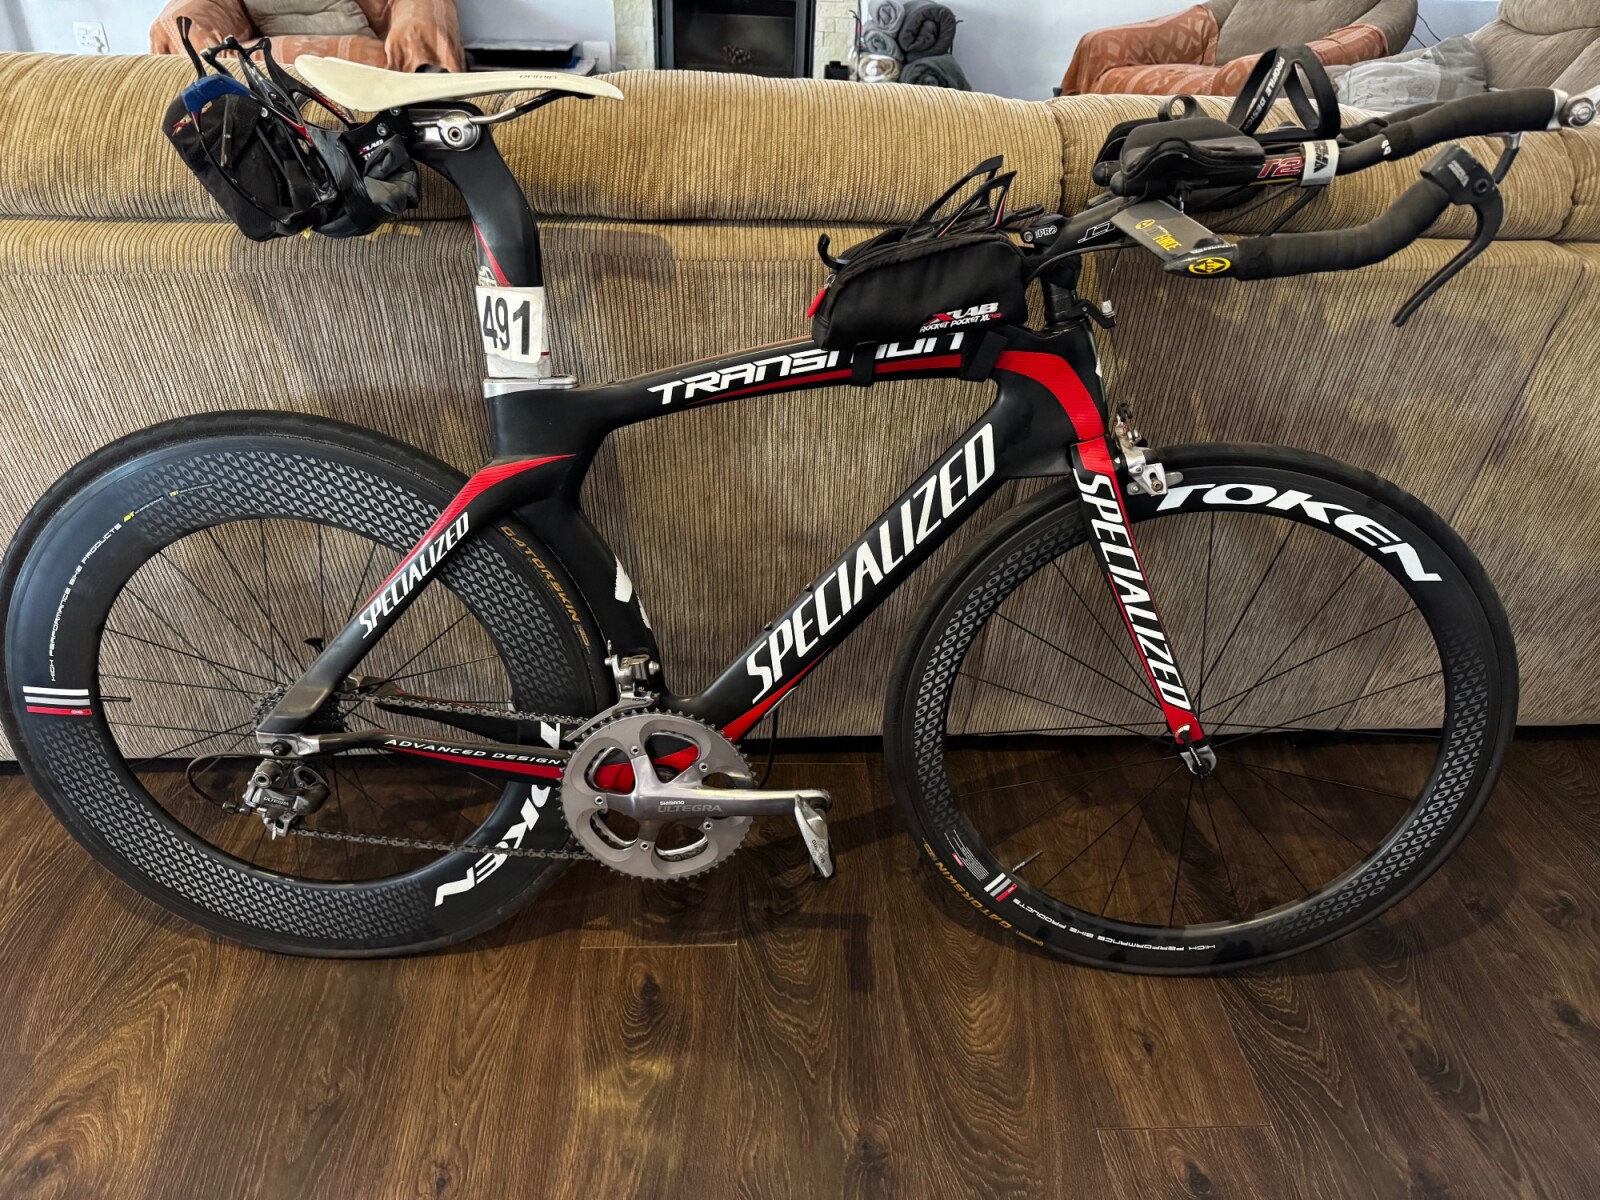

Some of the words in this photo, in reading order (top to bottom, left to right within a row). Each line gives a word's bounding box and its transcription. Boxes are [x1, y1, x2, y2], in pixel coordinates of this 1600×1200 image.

[1265, 56, 1286, 97] PROFILE
[1242, 97, 1266, 132] DESIGN
[482, 295, 531, 356] 491
[919, 322, 950, 334] ROCKET
[950, 316, 981, 328] POCKET
[647, 332, 964, 405] TRANSIION
[81, 523, 123, 564] PRODUCTS
[1156, 483, 1443, 582] TOKEN
[69, 565, 83, 586] BIKE
[359, 511, 469, 640] SPECIALIZED
[500, 525, 580, 623] GATORSKIN
[745, 422, 996, 705] SPECIALIZED
[1072, 468, 1192, 711] SPECIALIZED
[49, 587, 72, 657] PERFORMANCE
[49, 659, 57, 682] HIGH
[384, 739, 487, 757] ADVANCED
[491, 752, 561, 766] DESIGN
[656, 804, 723, 813] ULTEGRA
[935, 861, 1012, 929] GATORSKIN
[1012, 897, 1067, 930] PRODUCTS
[1069, 926, 1095, 939] BIKE
[1097, 935, 1185, 951] PERFORMANCE
